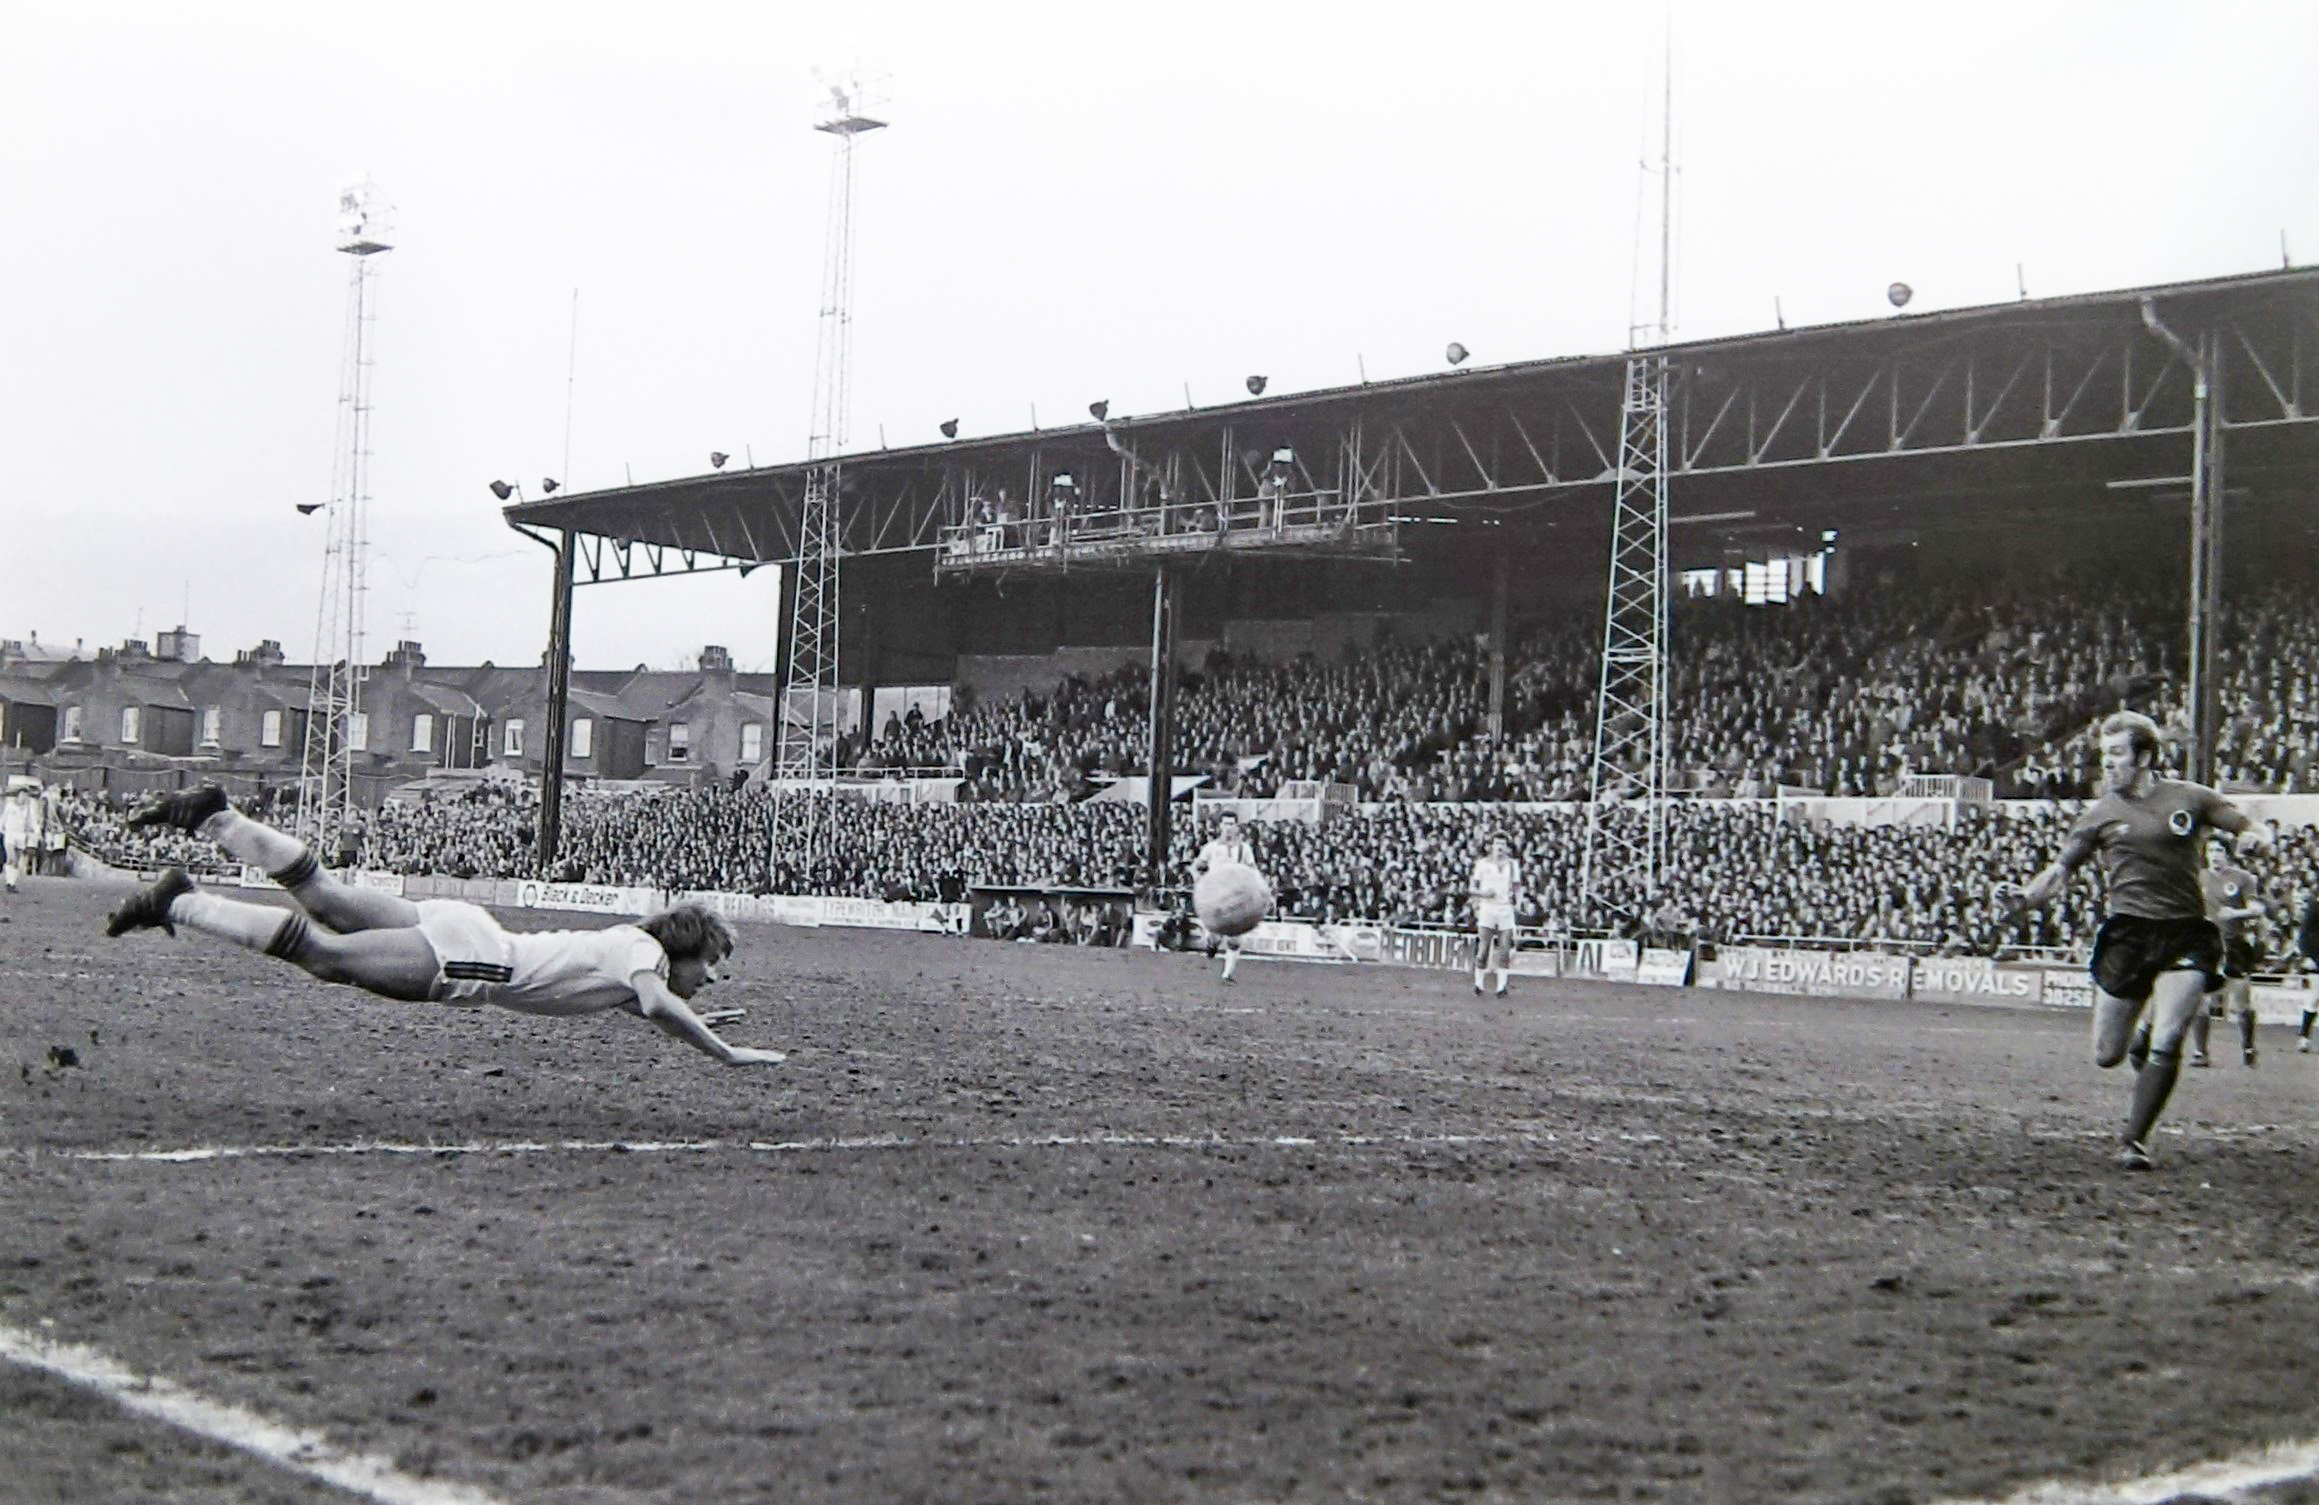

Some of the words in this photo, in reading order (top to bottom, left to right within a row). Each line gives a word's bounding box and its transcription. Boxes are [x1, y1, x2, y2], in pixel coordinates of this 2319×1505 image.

[542, 885, 568, 902] Black
[571, 890, 578, 904] &
[580, 887, 619, 906] Decker
